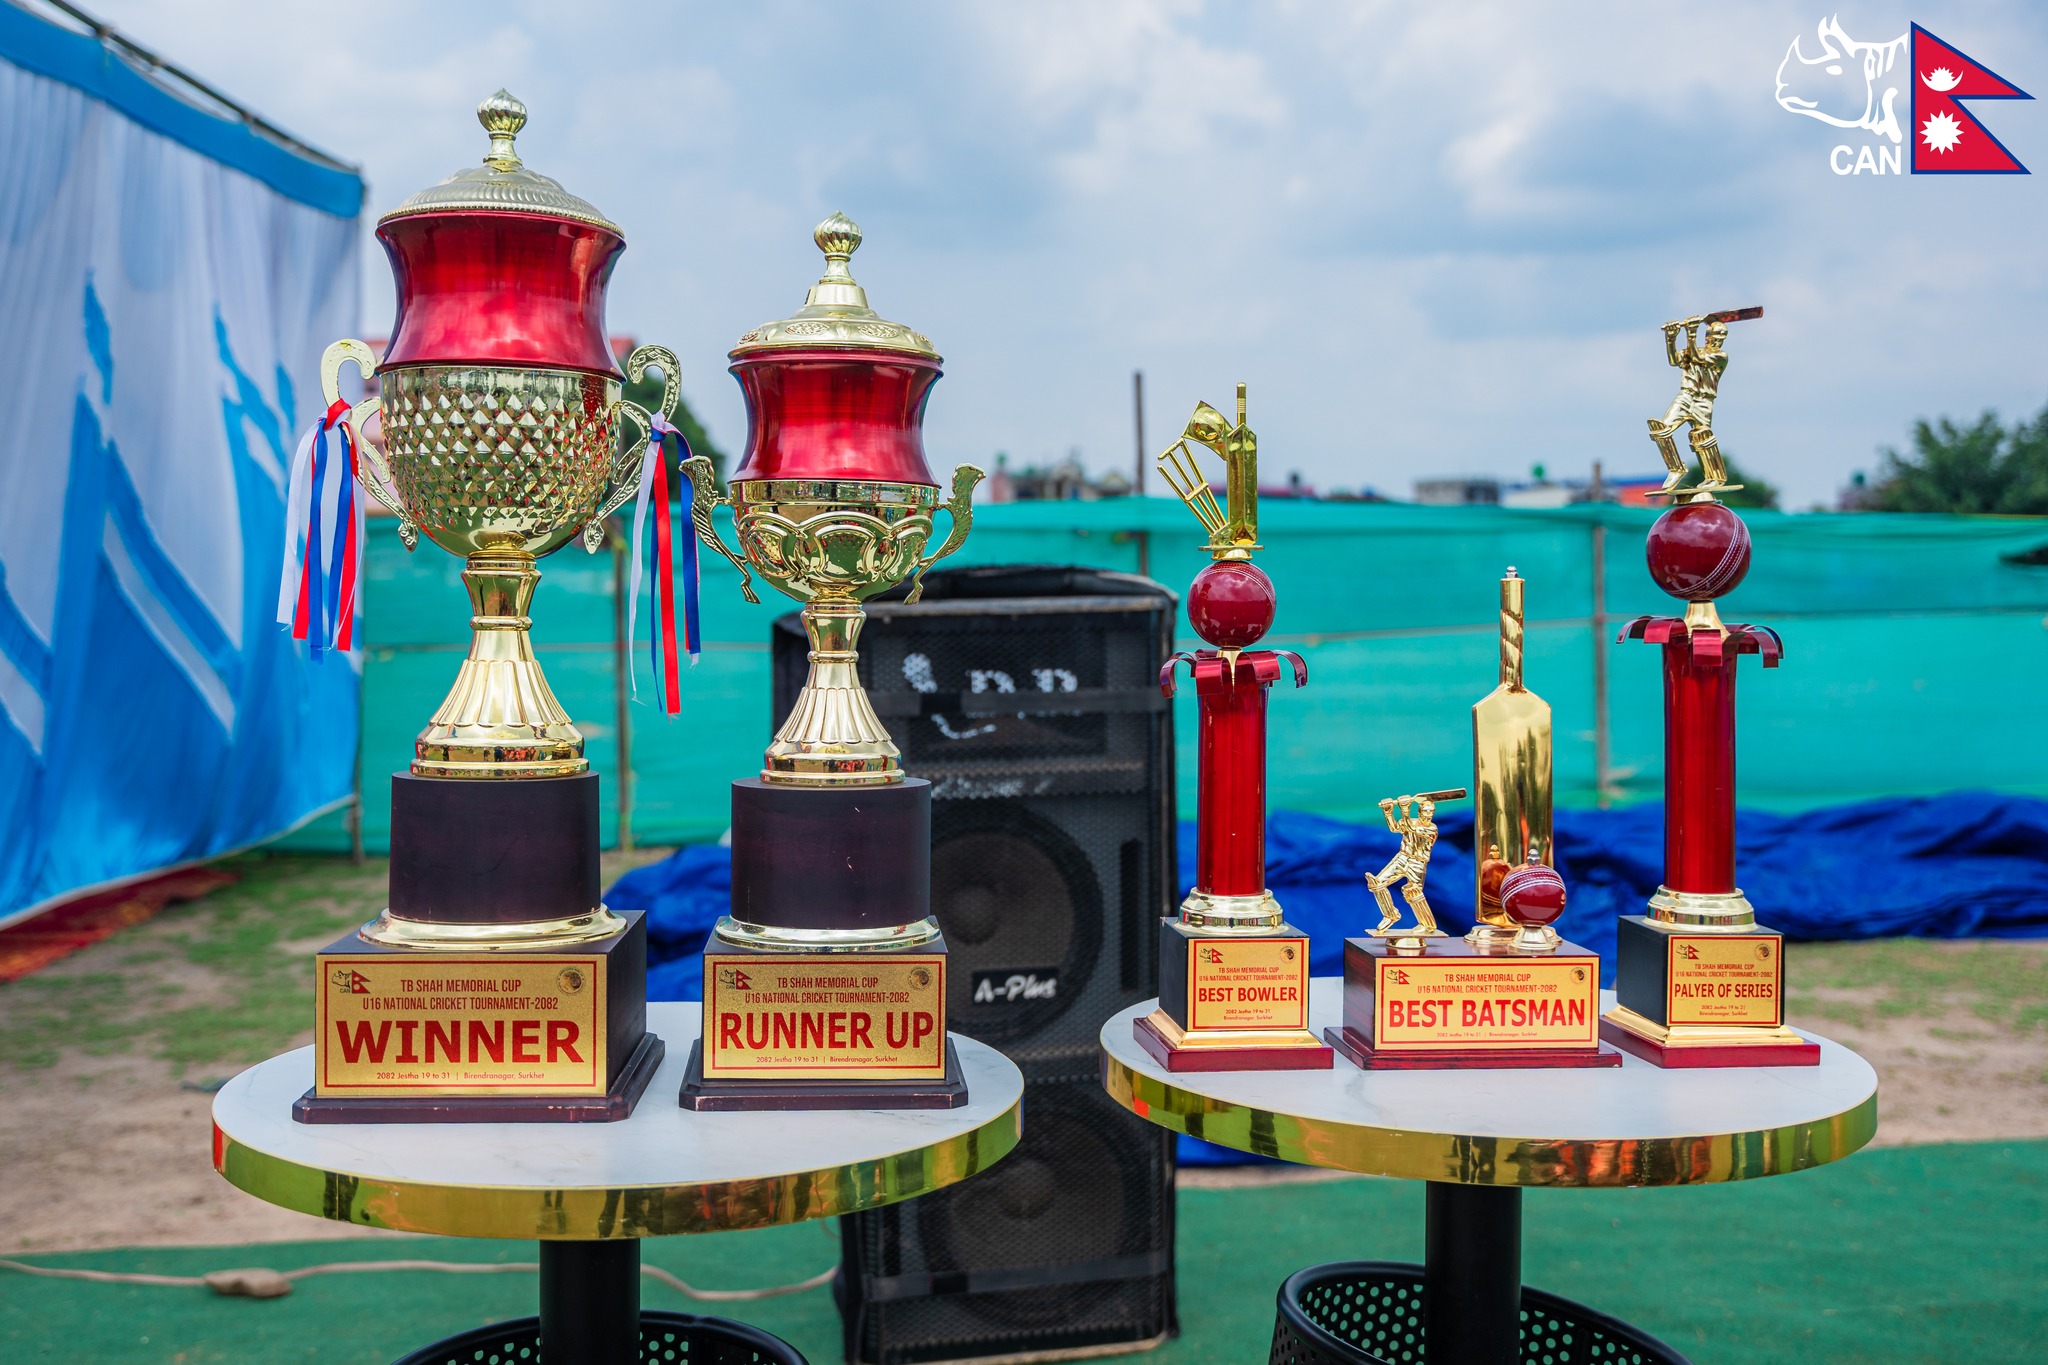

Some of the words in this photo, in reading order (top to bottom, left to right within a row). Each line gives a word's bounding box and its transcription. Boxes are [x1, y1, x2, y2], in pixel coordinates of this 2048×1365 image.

[777, 978, 788, 988] TB
[790, 978, 812, 988] SHAH
[815, 978, 859, 988] MEMORIAL
[862, 978, 878, 988] CUP
[1445, 974, 1454, 982] TB
[1456, 974, 1475, 982] SHAH
[1477, 974, 1514, 982] MEMORIAL
[1516, 974, 1531, 982] CUP
[401, 980, 414, 992] TB
[416, 980, 442, 992] SHAH
[446, 980, 498, 992] MEMORIAL
[502, 980, 521, 992] CUP
[974, 974, 1057, 1003] A-Plus
[1674, 984, 1714, 998] PALYER
[1718, 984, 1732, 998] OF
[1734, 984, 1772, 998] SERIES
[746, 992, 760, 1003] U16
[762, 992, 799, 1003] NATIONAL
[802, 992, 833, 1003] CRICKET
[835, 992, 910, 1003] TOURNAMENT-2082
[1199, 988, 1233, 1002] BEST
[1238, 988, 1298, 1002] BOWLER
[363, 998, 380, 1010] U16
[384, 998, 427, 1010] NATIONAL
[430, 998, 467, 1010] CRICKET
[470, 998, 558, 1010] TOURNAMENT-2082
[1390, 1000, 1453, 1027] BEST
[1462, 999, 1584, 1026] BATSMAN
[720, 1012, 874, 1049] RUNNER
[886, 1012, 934, 1049] UP
[336, 1020, 584, 1063] WINNER
